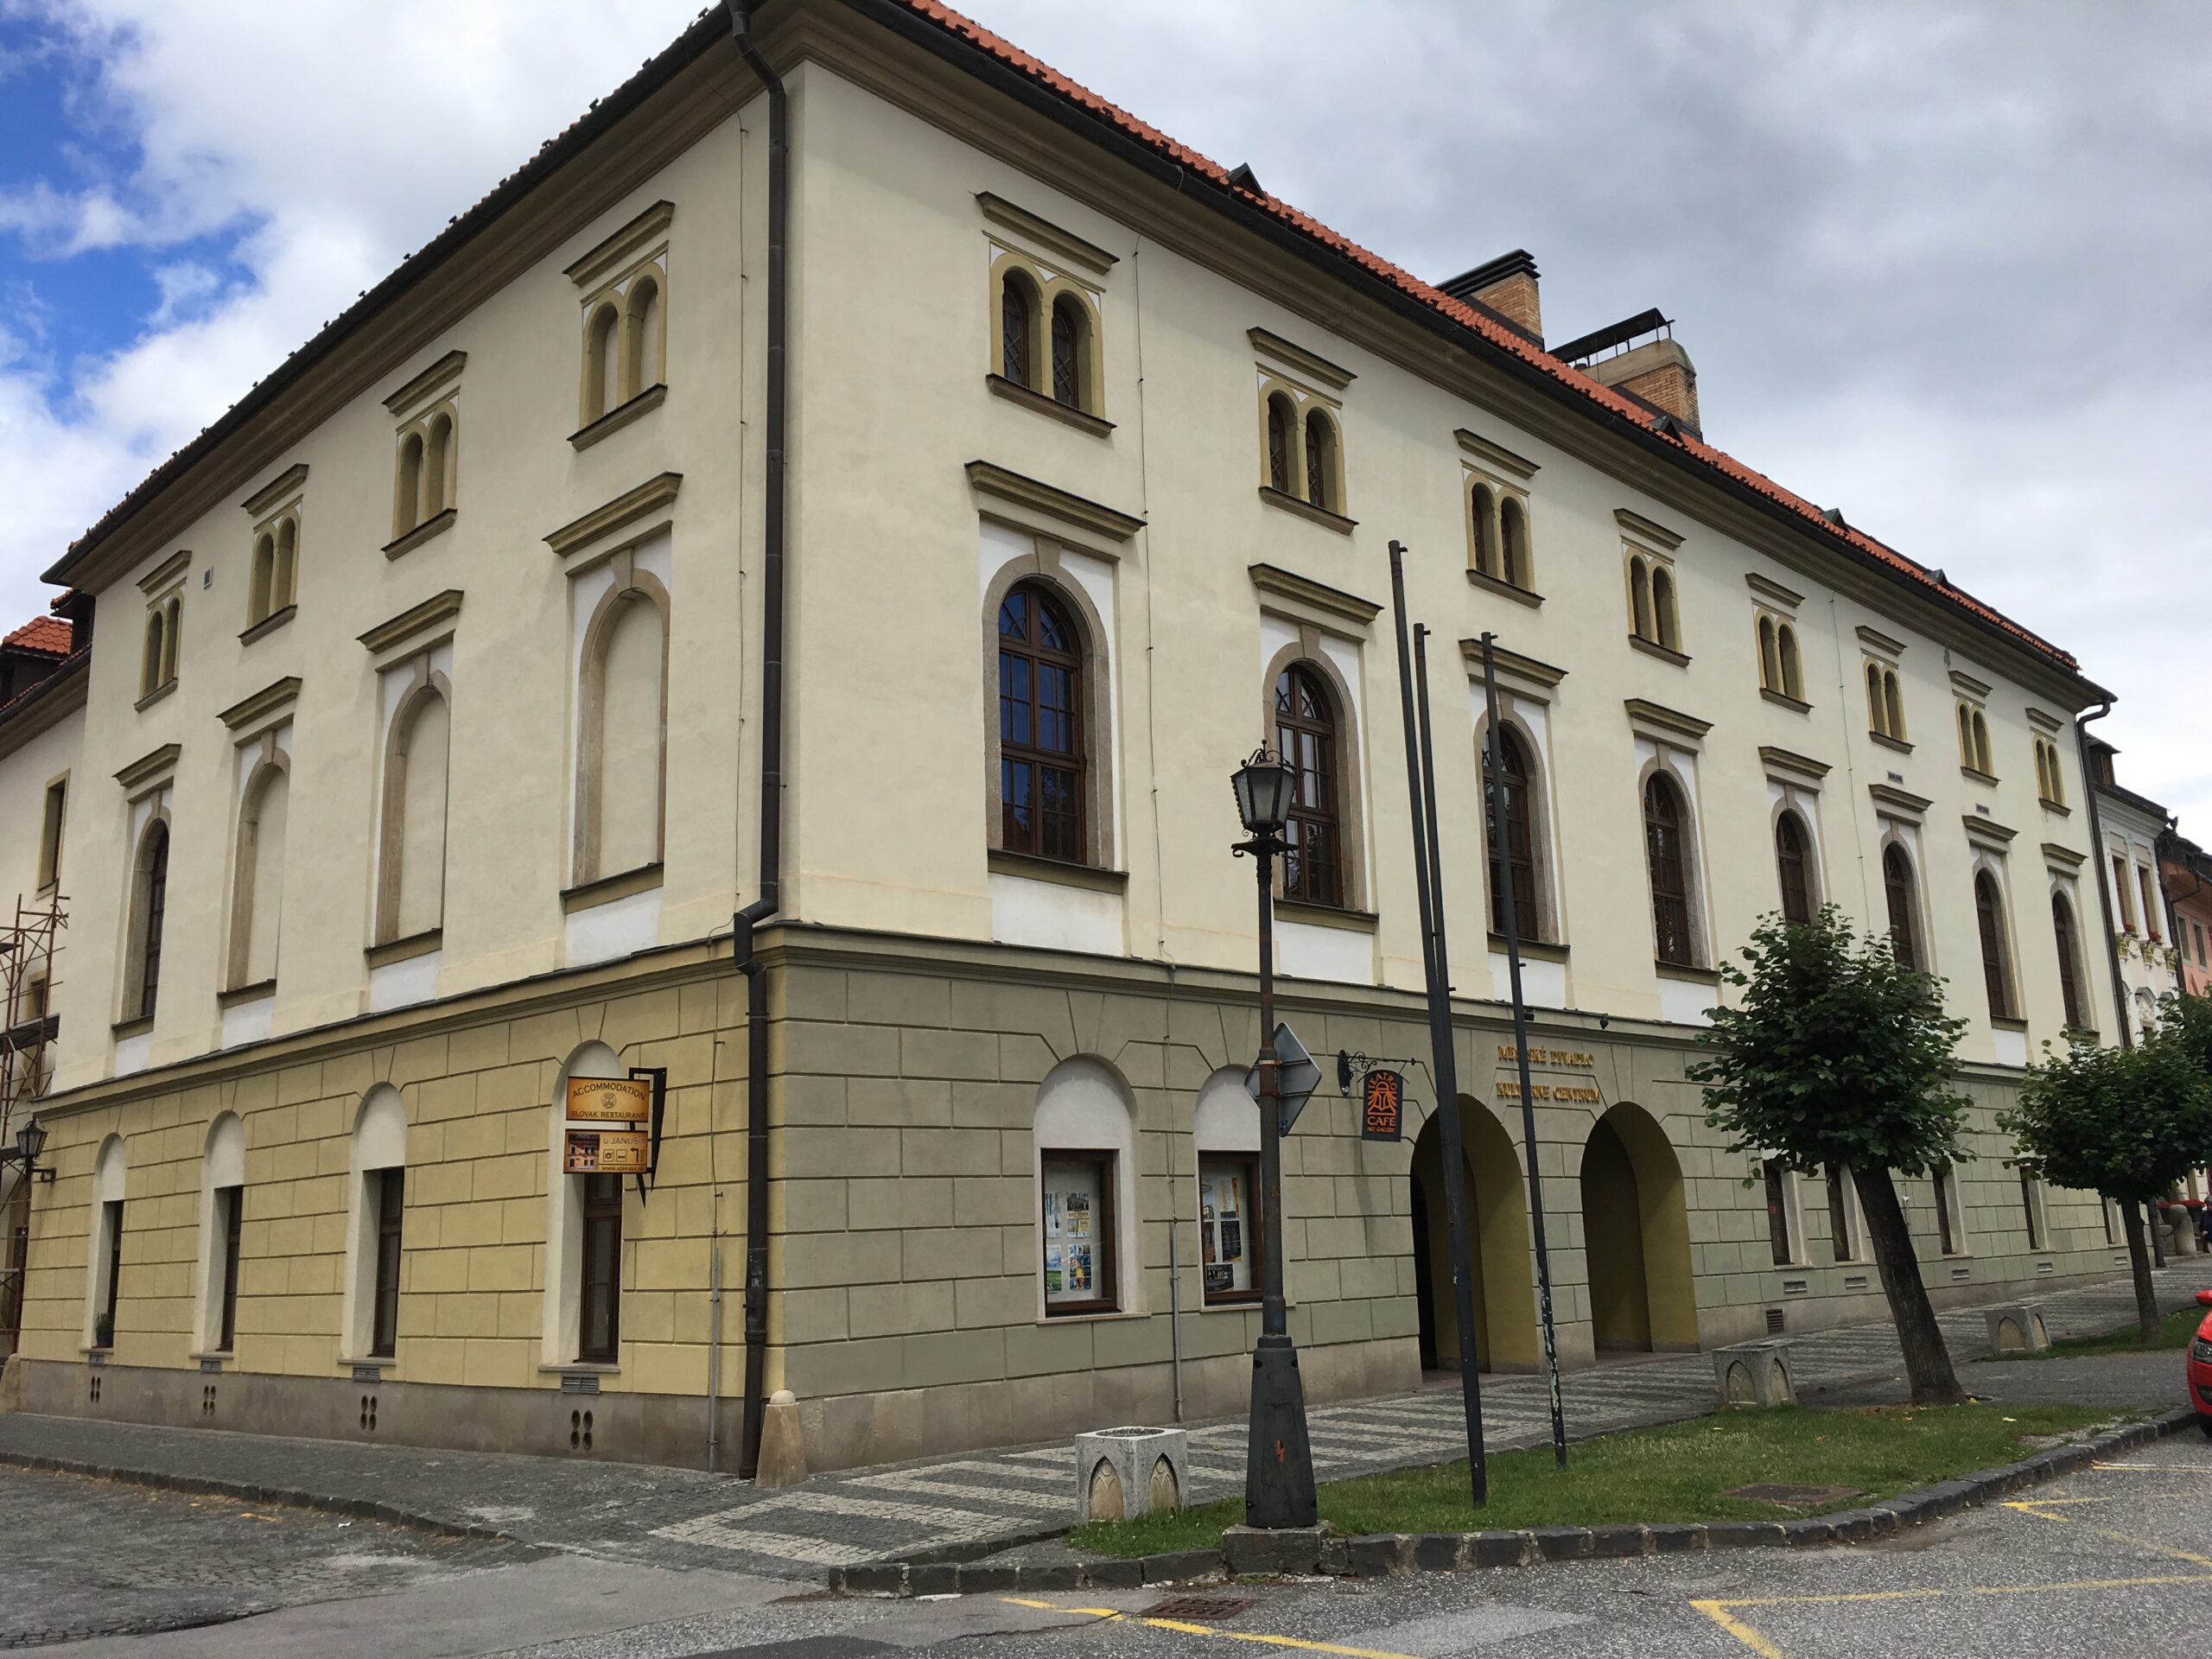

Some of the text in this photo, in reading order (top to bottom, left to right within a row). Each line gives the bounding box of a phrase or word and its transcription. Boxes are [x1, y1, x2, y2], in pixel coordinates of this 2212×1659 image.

[1549, 1050, 1593, 1066] DIVADLO
[1369, 1073, 1397, 1090] TEATRO
[573, 1083, 646, 1101] ACCOMMODATION
[1553, 1086, 1599, 1103] CENTRUM
